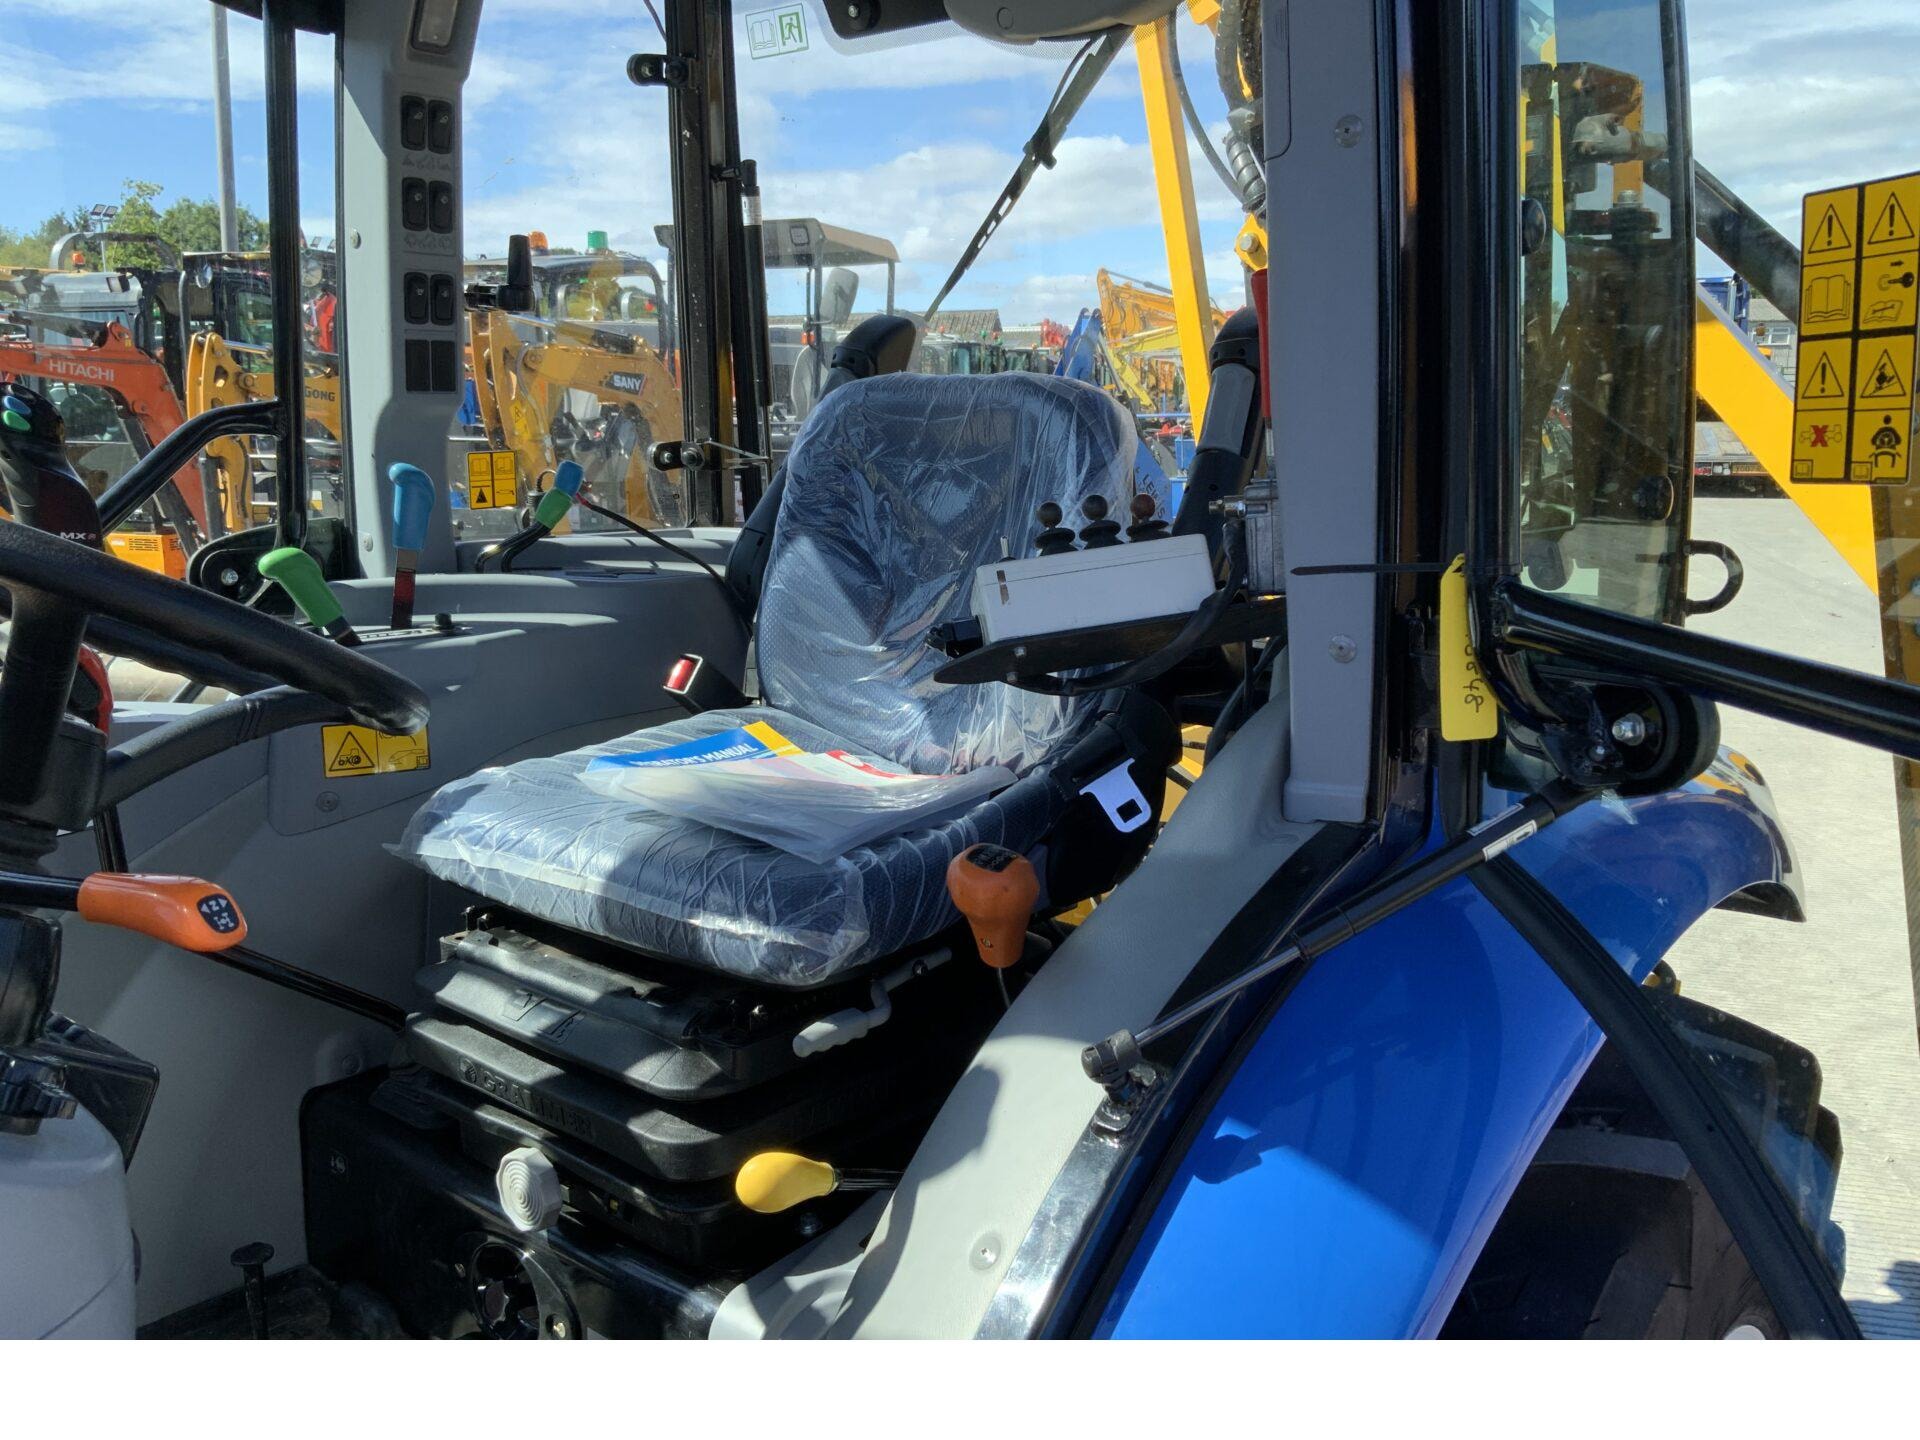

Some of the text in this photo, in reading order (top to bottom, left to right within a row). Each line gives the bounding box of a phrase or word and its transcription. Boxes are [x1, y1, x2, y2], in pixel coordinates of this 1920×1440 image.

[49, 359, 114, 382] HITACHI
[613, 374, 641, 391] SANY
[703, 743, 759, 762] MANUAL
